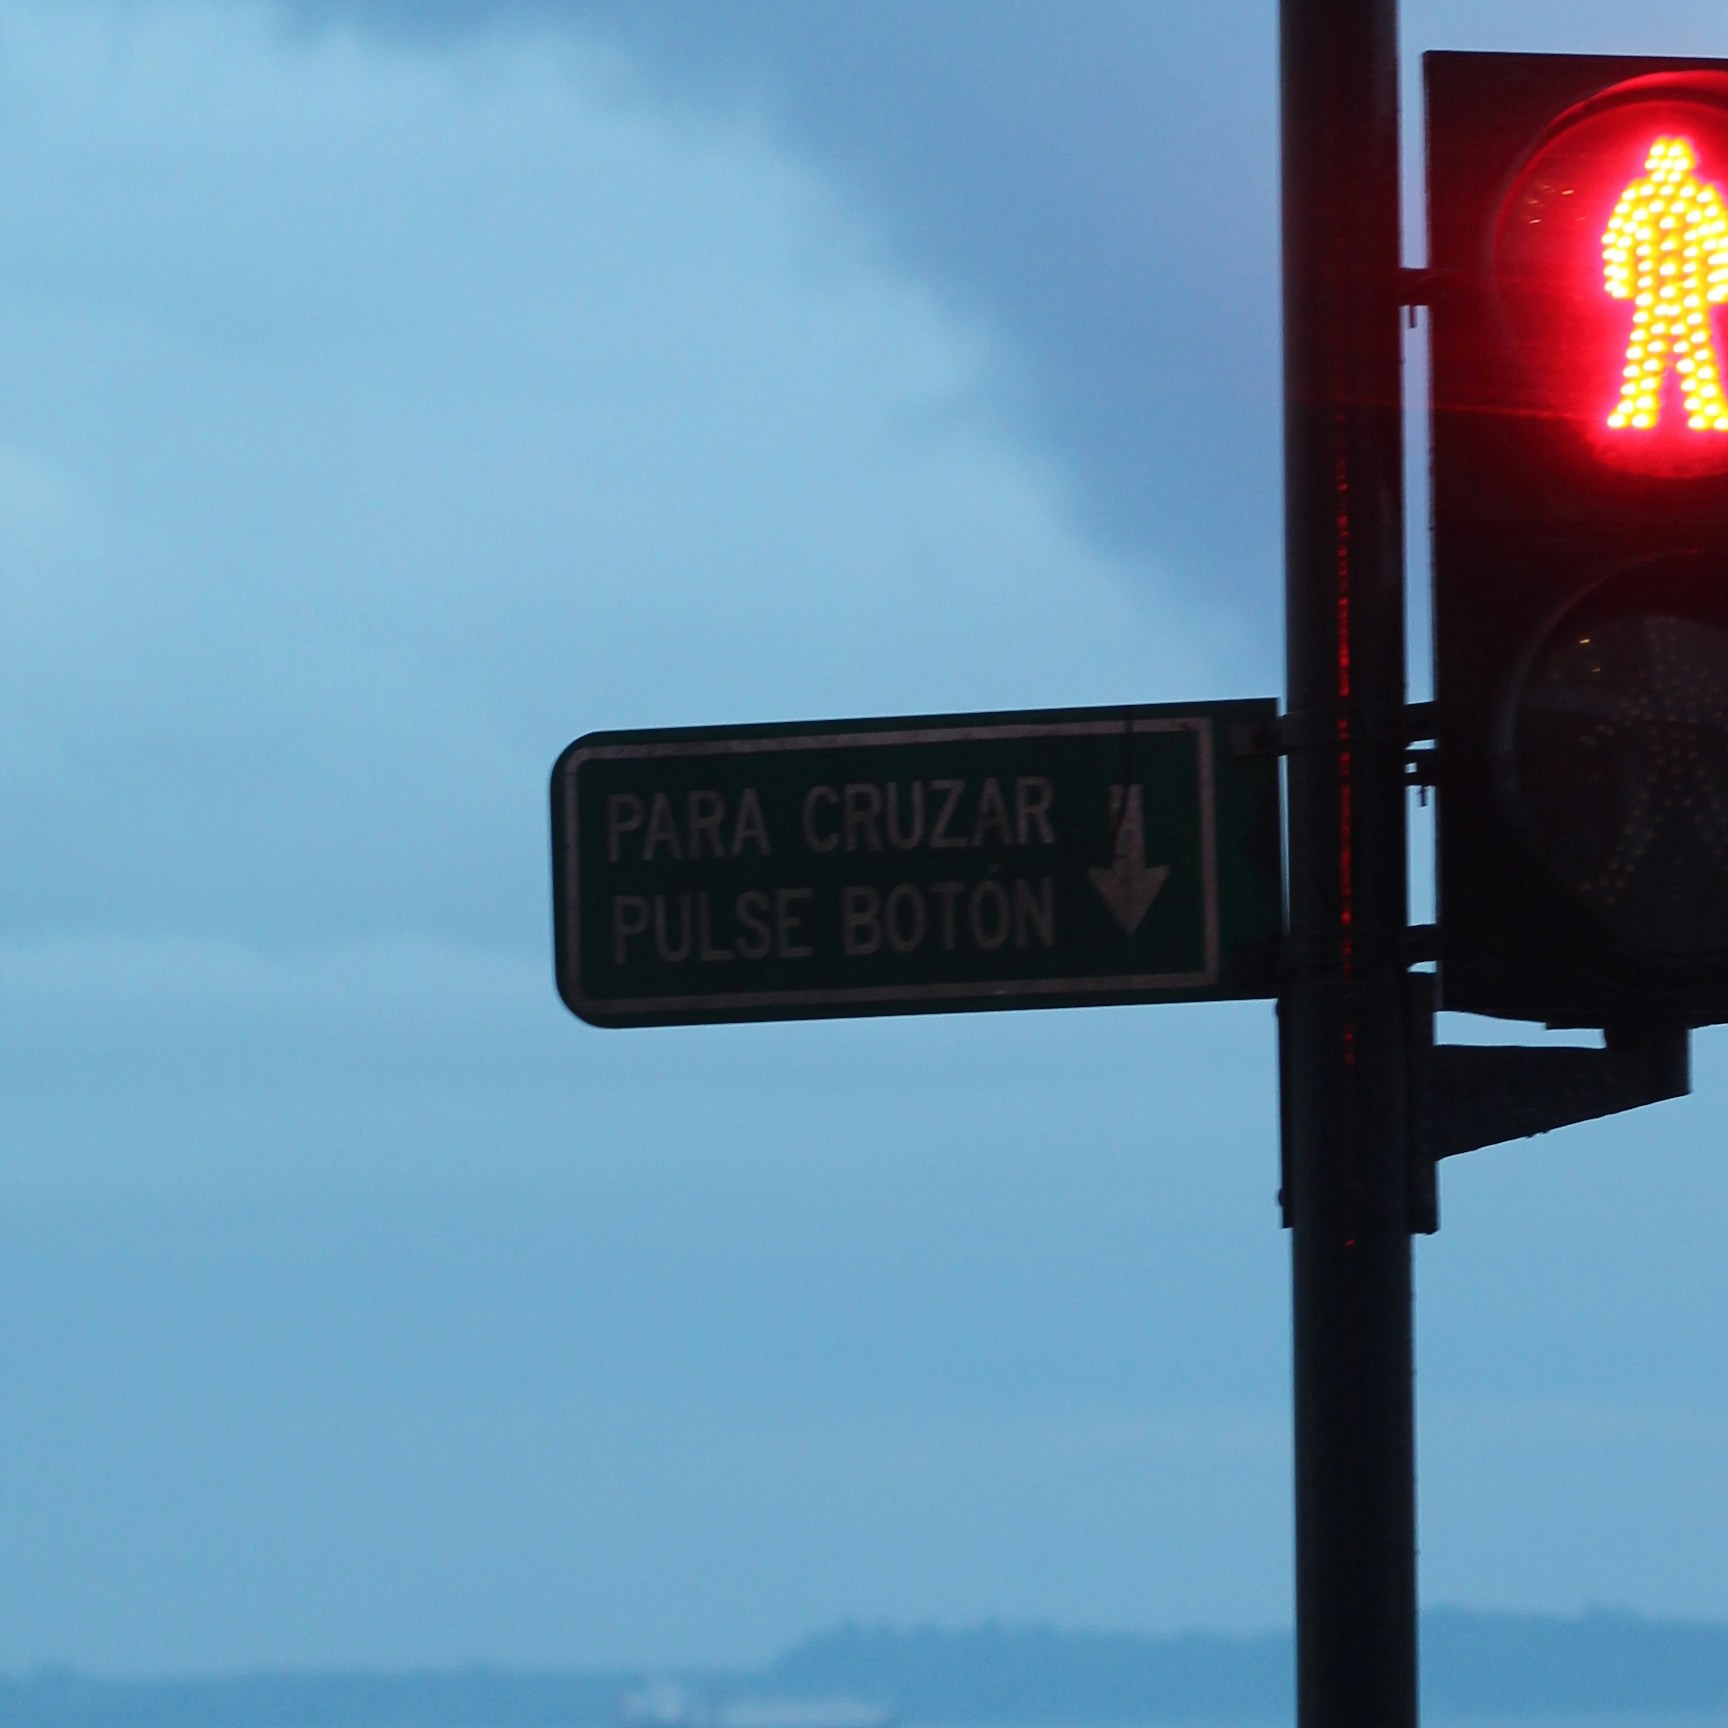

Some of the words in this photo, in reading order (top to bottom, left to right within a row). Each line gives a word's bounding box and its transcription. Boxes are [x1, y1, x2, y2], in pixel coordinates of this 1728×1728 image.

[606, 788, 772, 863] PARA
[801, 776, 1055, 853] CRUZAR
[611, 888, 815, 966] PULSE
[843, 864, 1055, 956] BOTÓN
